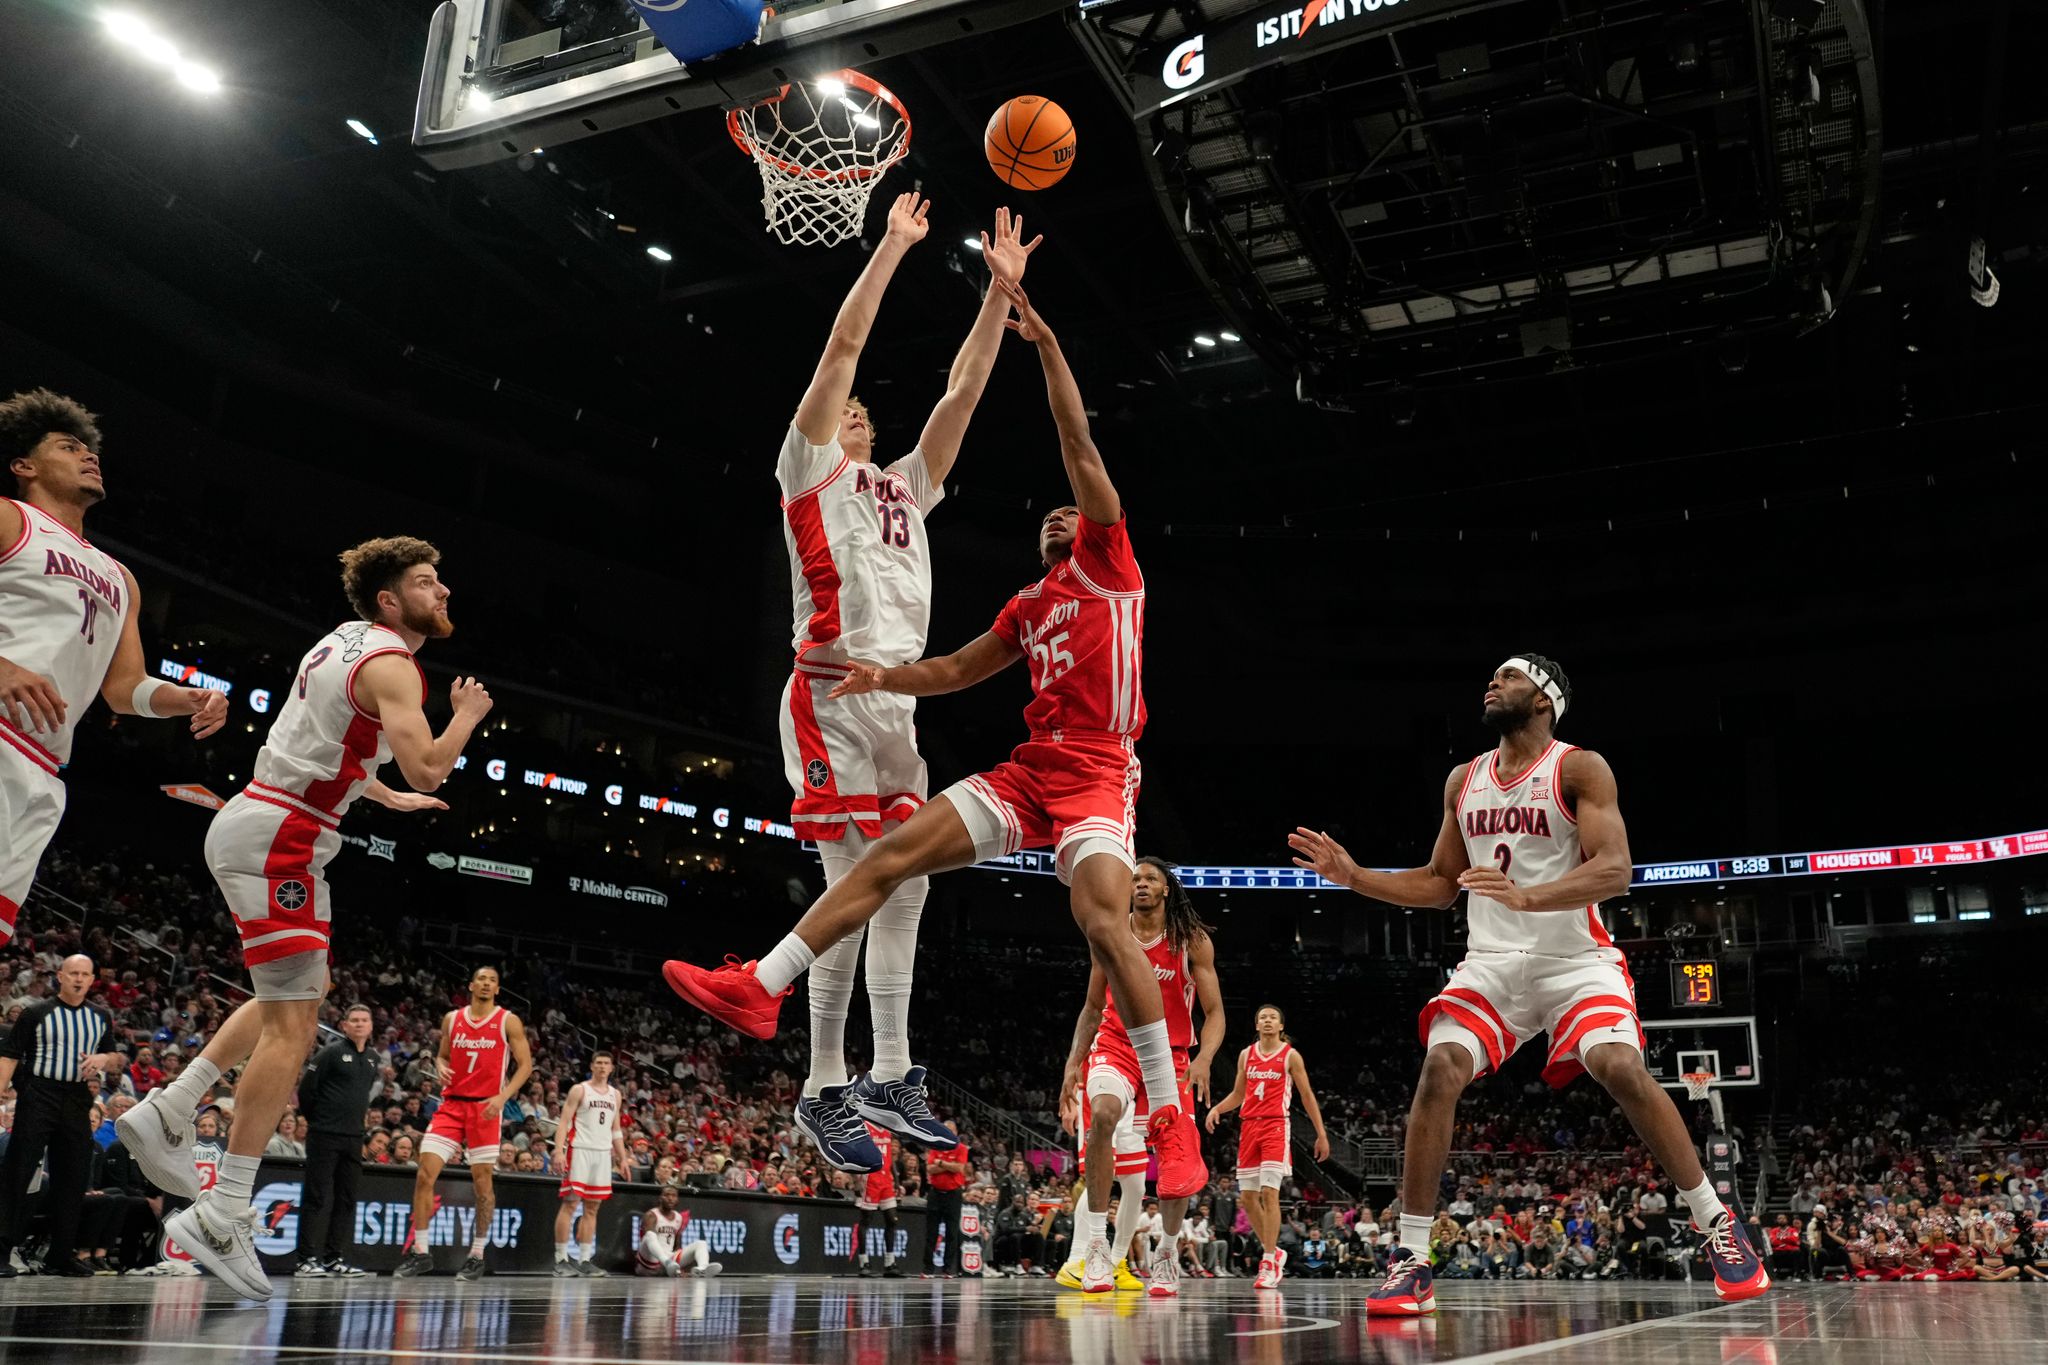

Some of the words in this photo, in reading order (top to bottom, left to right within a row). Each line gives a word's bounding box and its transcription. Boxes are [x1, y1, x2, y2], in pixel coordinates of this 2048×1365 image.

[1256, 17, 1279, 48] IS
[1280, 8, 1303, 40] IT
[1319, 0, 1345, 27] IN
[1162, 34, 1205, 90] G
[877, 504, 910, 549] 13
[44, 549, 120, 616] ARIZONA
[79, 589, 97, 645] 10
[161, 659, 174, 676] IS
[174, 663, 184, 680] IT
[1032, 631, 1075, 690] 25
[299, 646, 333, 700] 3
[250, 689, 271, 713] G
[486, 759, 506, 781] G
[524, 770, 535, 785] IS
[534, 772, 545, 787] IT
[550, 776, 561, 790] IN
[561, 777, 587, 795] YOU?
[605, 785, 623, 805] G
[639, 794, 650, 808] IS
[649, 796, 658, 810] IT
[671, 802, 697, 818] YOU?
[713, 808, 729, 827] G
[744, 817, 755, 830] IS
[754, 819, 762, 832] IT
[1466, 807, 1551, 838] ARIZONA
[1732, 858, 1770, 875] 9:39
[1789, 859, 1804, 869] 1ST
[1816, 851, 1892, 869] HOUSTON
[1912, 847, 1935, 864] 14
[465, 861, 486, 871] BORN
[495, 865, 526, 877] BREWED
[1643, 864, 1711, 881] ARIZONA
[582, 879, 622, 899] Mobile
[624, 891, 664, 906] CENTER
[1196, 877, 1204, 887] 0
[1222, 877, 1230, 887] 0
[1247, 877, 1255, 887] 0
[1271, 877, 1279, 887] 0
[1296, 877, 1304, 887] 0
[1683, 964, 1713, 978] 9:39
[1689, 978, 1711, 1001] 13
[453, 1033, 496, 1048] Houston
[466, 1051, 478, 1073] 7
[1247, 1066, 1281, 1080] Houston
[1254, 1081, 1265, 1101] 4
[599, 1111, 605, 1125] 8
[194, 1151, 216, 1161] LLIPS
[199, 1166, 212, 1189] 6
[354, 1201, 383, 1246] IS
[383, 1203, 410, 1245] IT
[457, 1206, 522, 1248] YU?
[963, 1218, 977, 1229] 66
[701, 1219, 746, 1254] YOU?
[774, 1213, 800, 1265] G
[824, 1225, 838, 1256] IS
[838, 1226, 852, 1256] IT
[966, 1255, 979, 1266] 66
